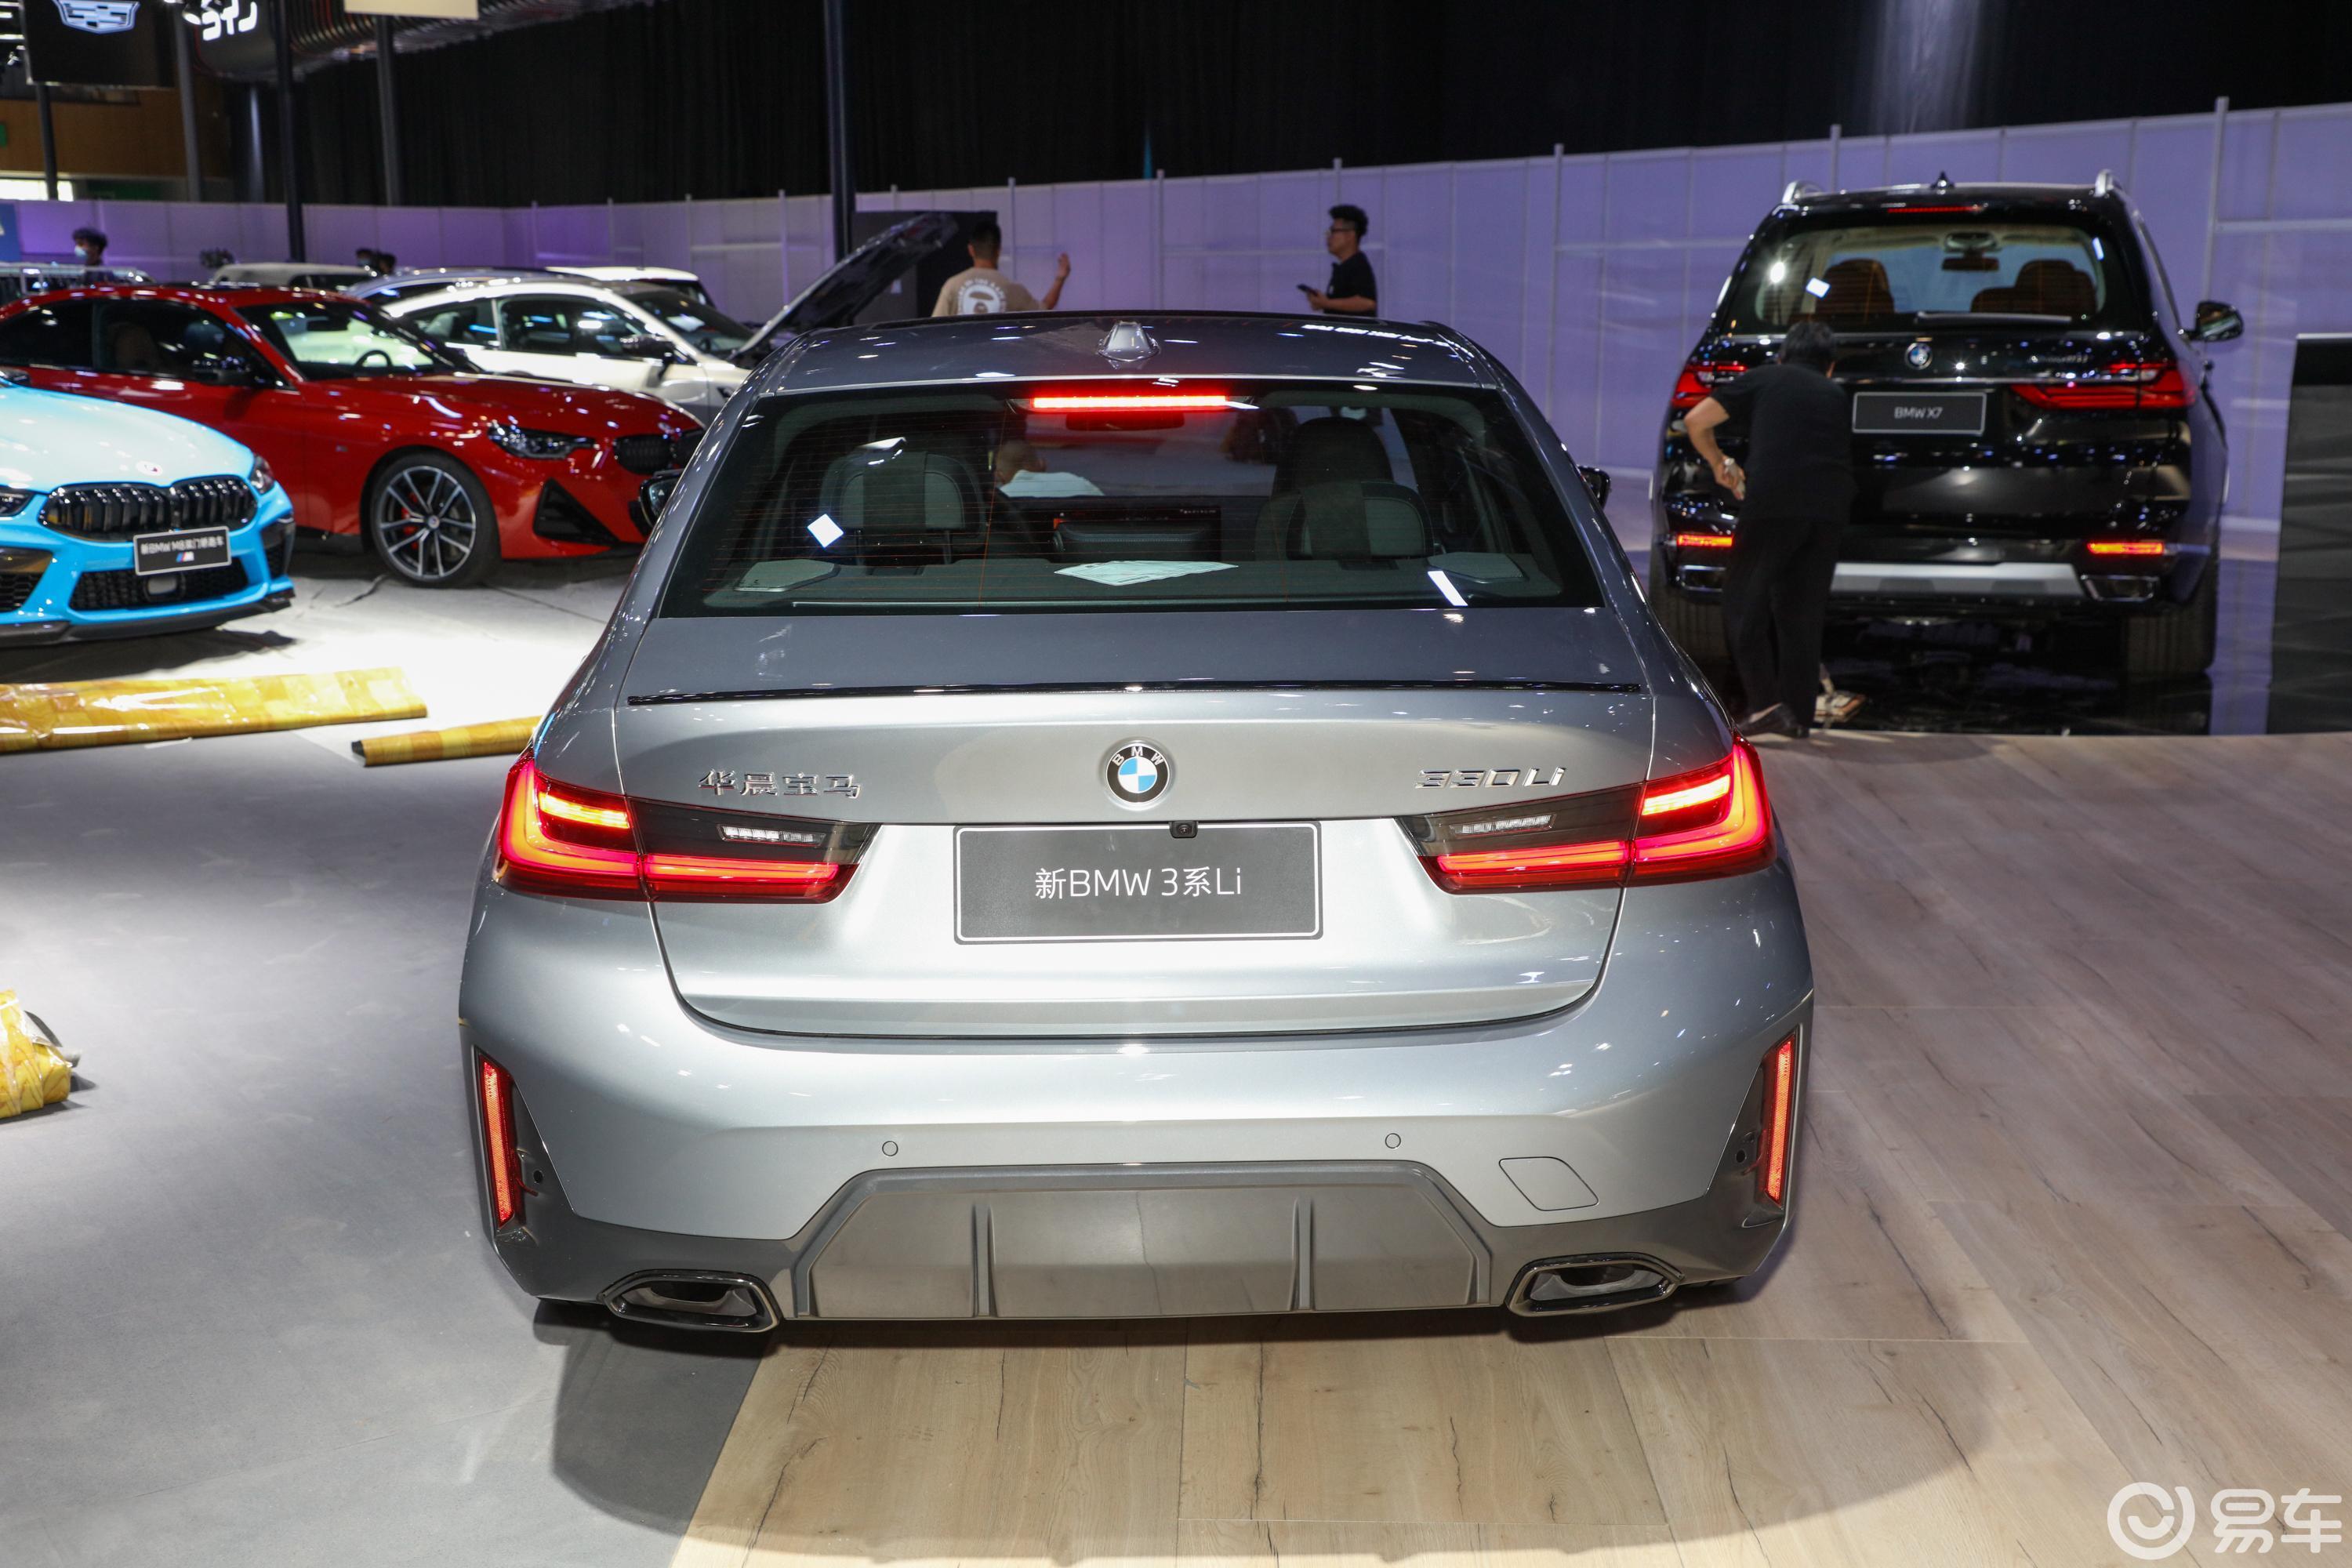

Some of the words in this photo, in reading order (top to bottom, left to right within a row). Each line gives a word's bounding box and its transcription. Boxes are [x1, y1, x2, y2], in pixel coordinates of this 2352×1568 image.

[1894, 406, 1926, 419] BMW
[1926, 406, 1944, 419] X7
[1112, 746, 1164, 766] BMW
[699, 768, 861, 799] 华晨宝马
[1414, 767, 1566, 789] 330Li
[1034, 867, 1152, 899] 新BMW
[1160, 866, 1242, 897] 3系Li
